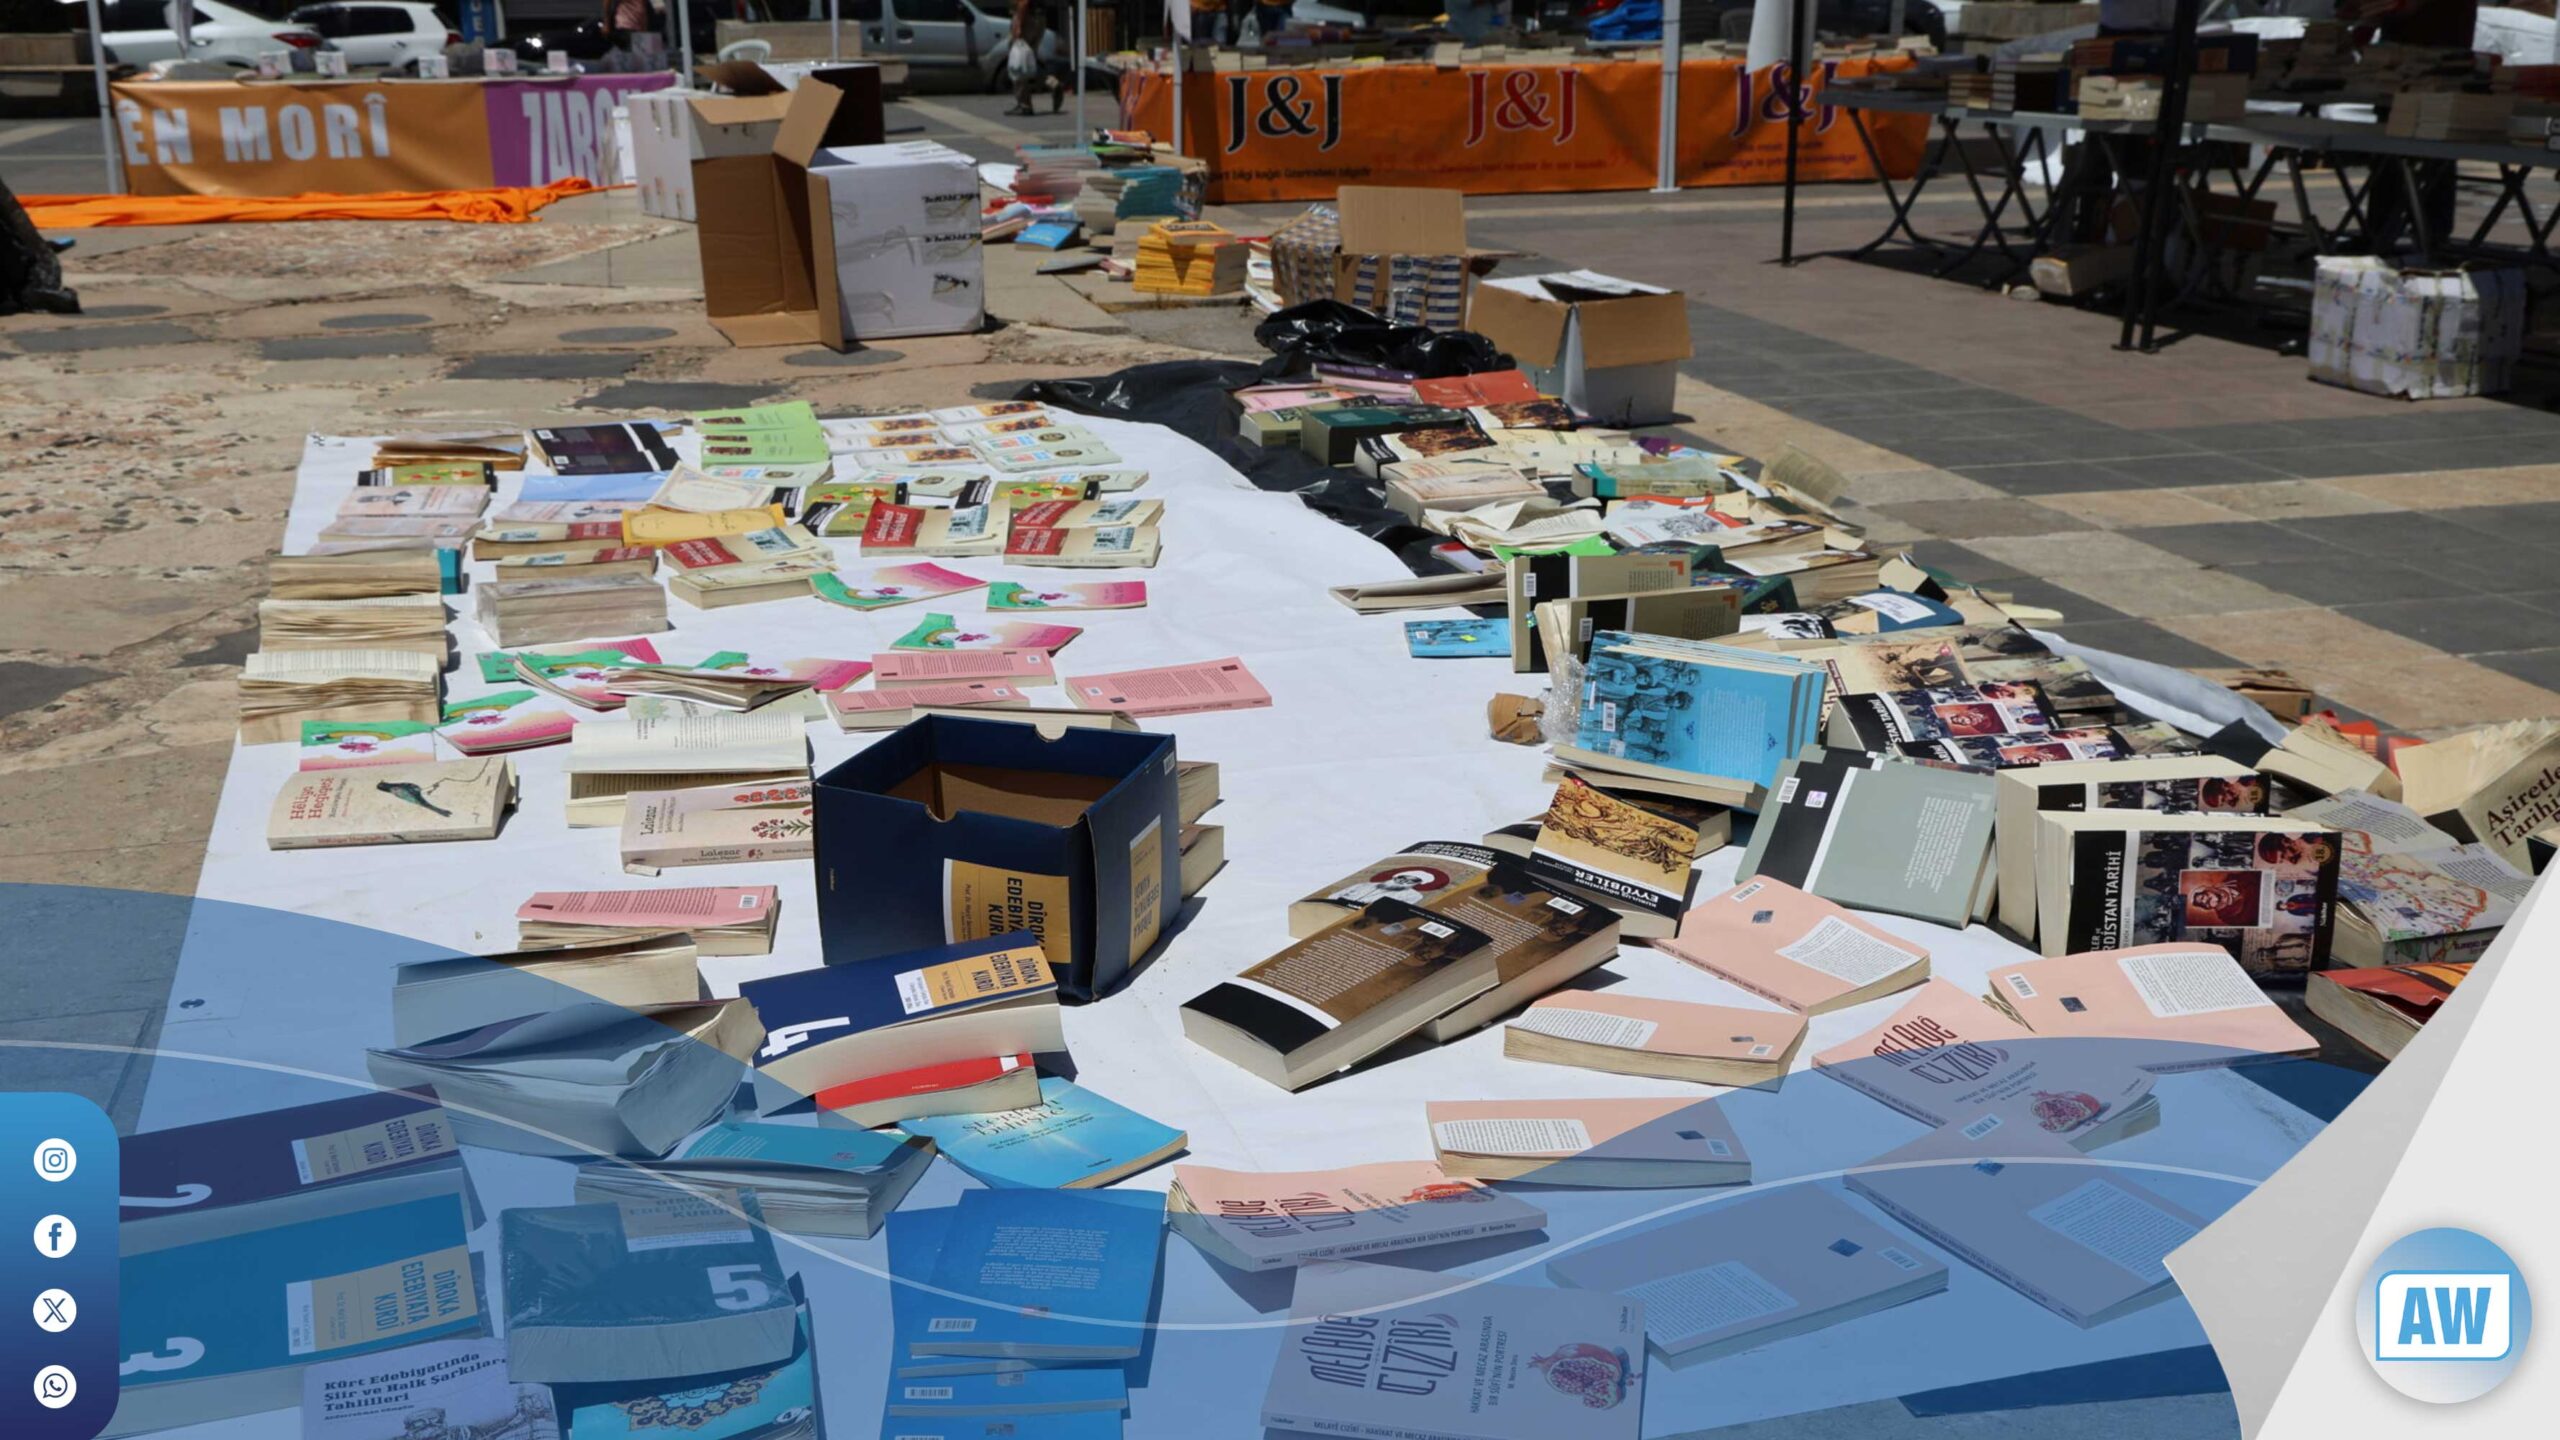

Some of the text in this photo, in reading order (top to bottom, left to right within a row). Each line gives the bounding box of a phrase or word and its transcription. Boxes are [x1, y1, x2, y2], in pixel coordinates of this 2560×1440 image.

[1226, 74, 1345, 154] J&J
[1465, 69, 1580, 147] J&J
[1732, 59, 1840, 139] J&J
[117, 93, 390, 165] ÊN MORÎ
[2487, 766, 2560, 831] Aşiretle
[1575, 869, 1661, 903] EYYÜBİLER
[2100, 850, 2122, 950] RDİSTAN TARİHİ
[988, 903, 1005, 940] KUR
[1006, 876, 1024, 940] EDEBIYA
[1026, 899, 1047, 949] DÎROK
[971, 967, 996, 993] KURDÎ
[989, 952, 1018, 989] EDEBIYATA
[1016, 957, 1042, 985] DÎROKA
[365, 1139, 389, 1165] KURDÎ
[385, 1118, 414, 1159] EDEBIYATA
[415, 1120, 442, 1152] DÎROKA
[400, 1260, 431, 1325] EDEBIYATA
[432, 1267, 463, 1317] DÎROKA
[707, 1264, 771, 1311] 5
[373, 1292, 401, 1332] KURDÎ
[1480, 1314, 1496, 1352] ARASINDA
[324, 1353, 480, 1391] Kürt Edebiyatında
[324, 1391, 358, 1403] Şiir
[362, 1387, 382, 1397] ve
[386, 1378, 427, 1393] Halk
[323, 1392, 410, 1412] Tahlilleri
